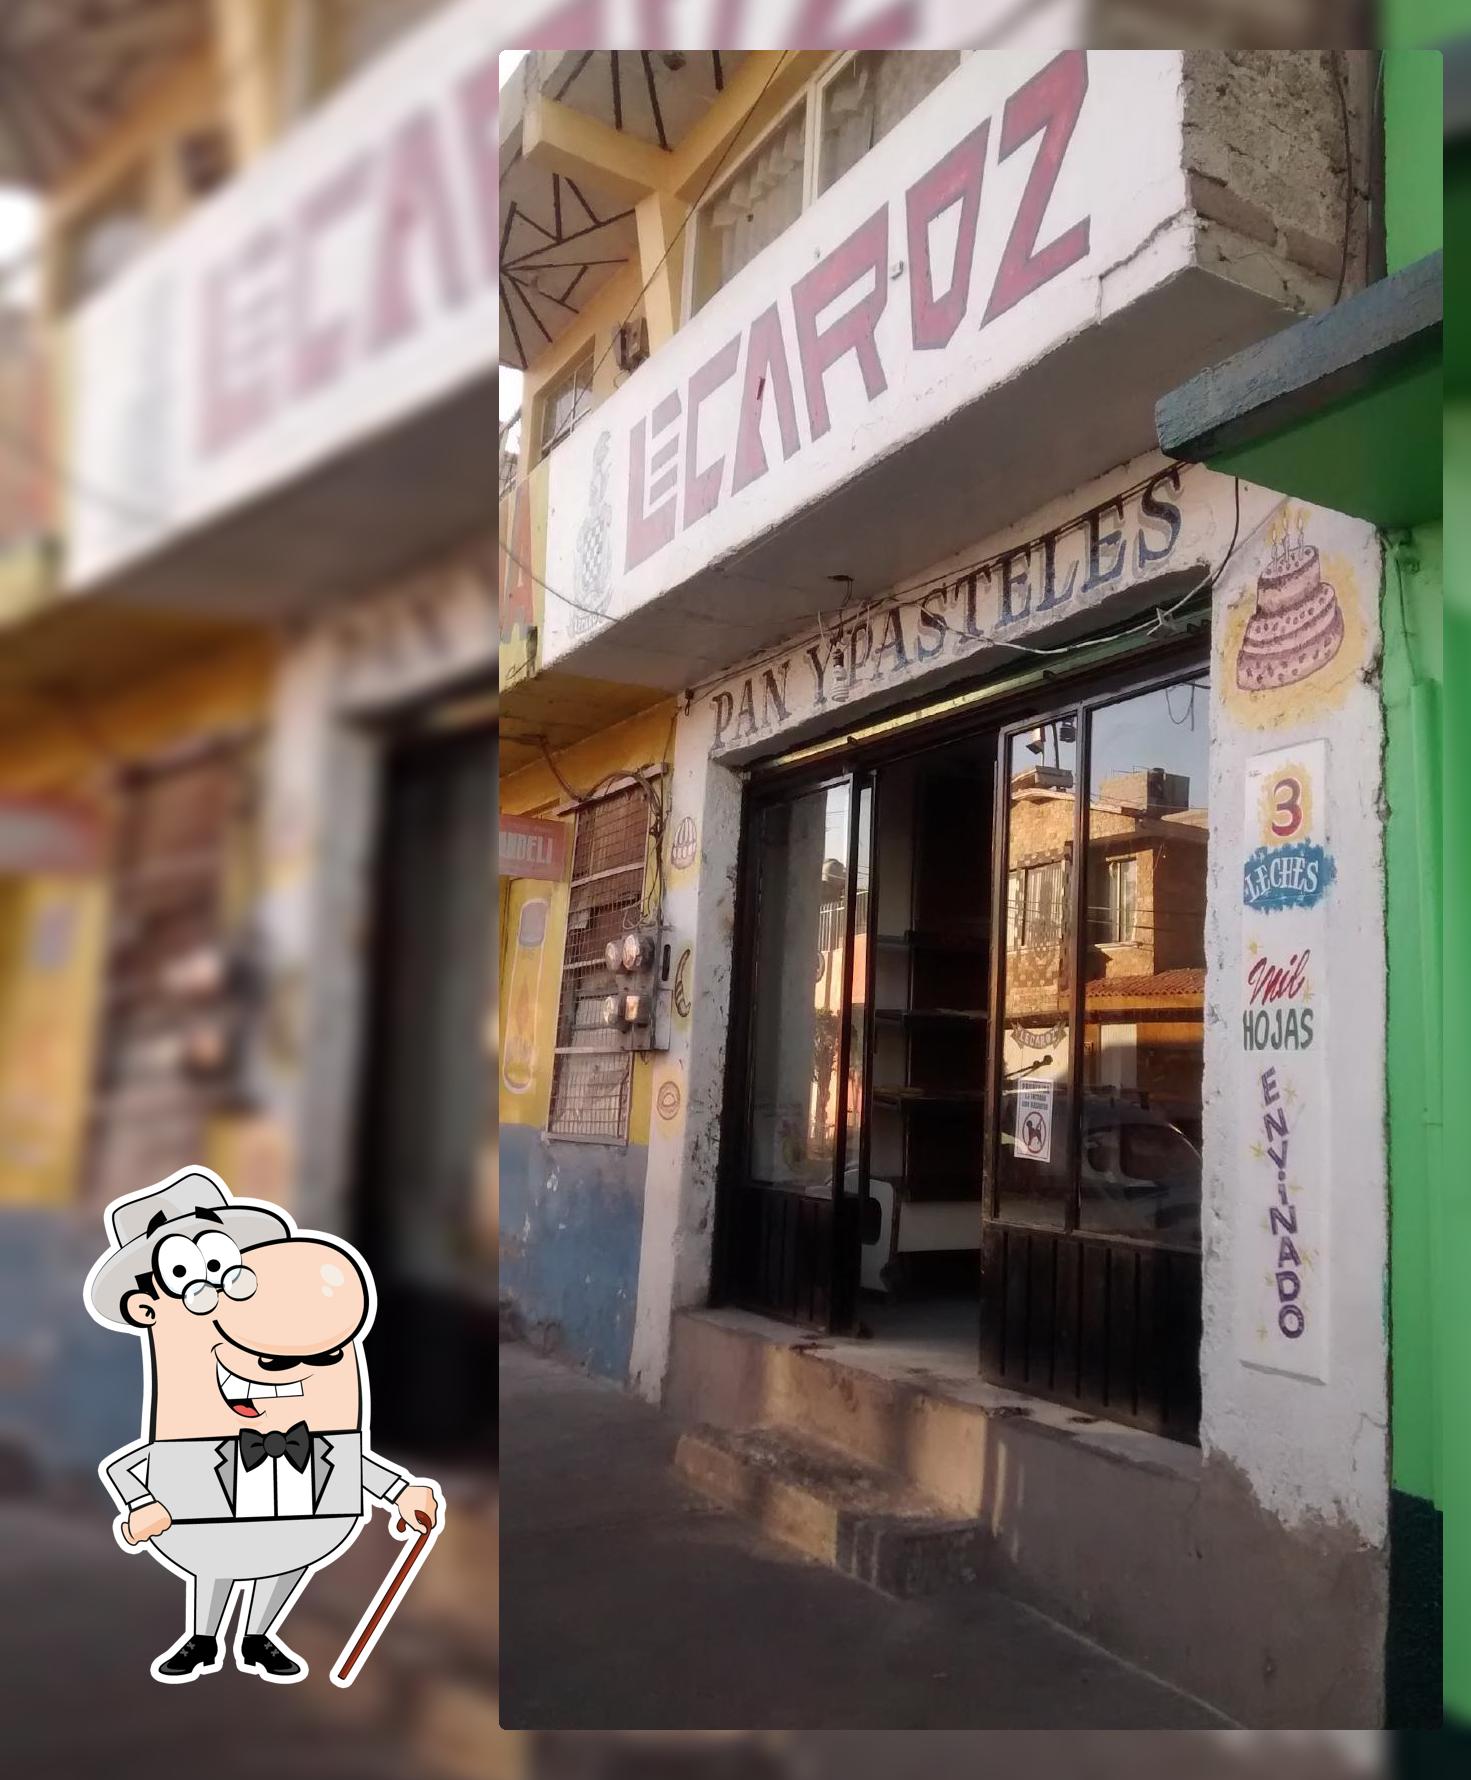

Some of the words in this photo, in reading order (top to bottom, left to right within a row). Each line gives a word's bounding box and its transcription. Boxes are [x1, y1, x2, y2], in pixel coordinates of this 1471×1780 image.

[712, 659, 792, 750] PAN
[806, 637, 840, 706] Y
[848, 467, 1183, 685] PASTELES
[1271, 777, 1302, 837] 3
[1244, 856, 1320, 902] LECHES
[1242, 1008, 1314, 1051] HOJAS
